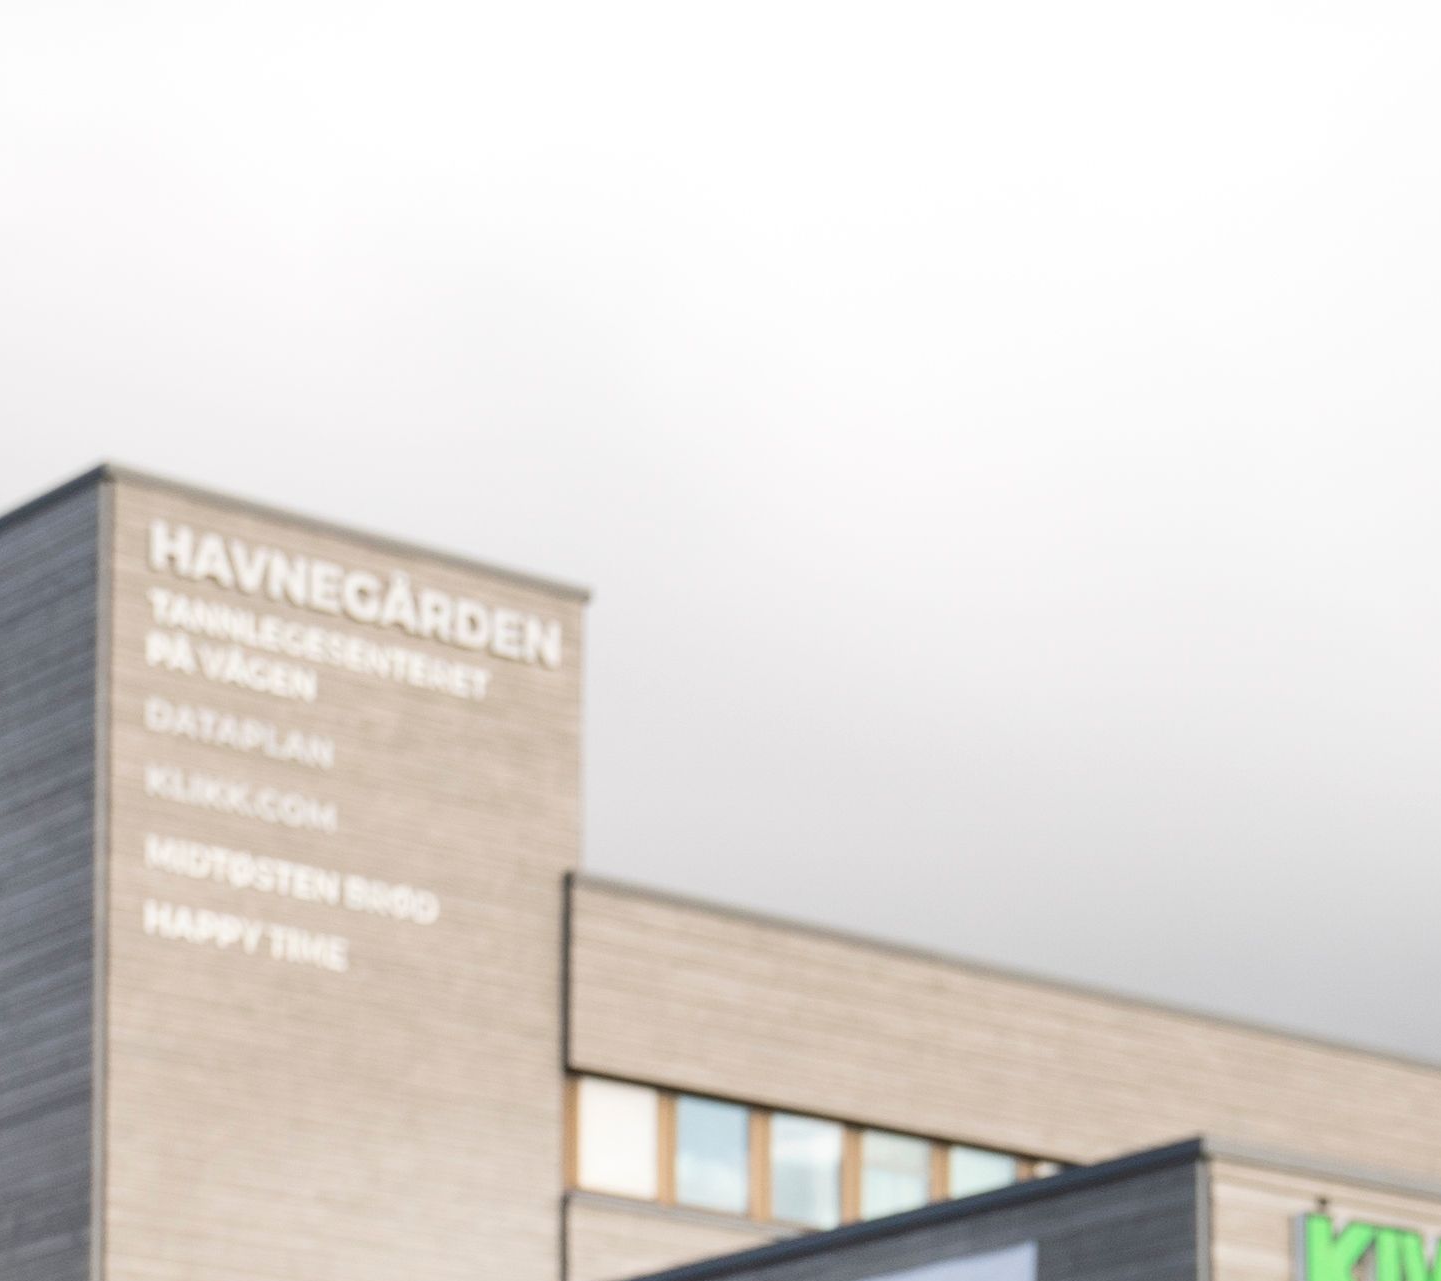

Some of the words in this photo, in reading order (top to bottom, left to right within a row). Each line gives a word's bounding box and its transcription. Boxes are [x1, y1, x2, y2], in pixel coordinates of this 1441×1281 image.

[150, 521, 561, 668] HAVNEGÅRDEN
[146, 630, 196, 673] PÅ
[199, 642, 317, 701] VÅGEN
[147, 588, 491, 699] TANNLEGESENTERET
[144, 696, 335, 769] DATAPLAN
[145, 764, 338, 834] KLIKK.COM
[143, 899, 262, 954] HAPPY
[272, 925, 349, 971] TIME
[344, 874, 440, 924] BRØD
